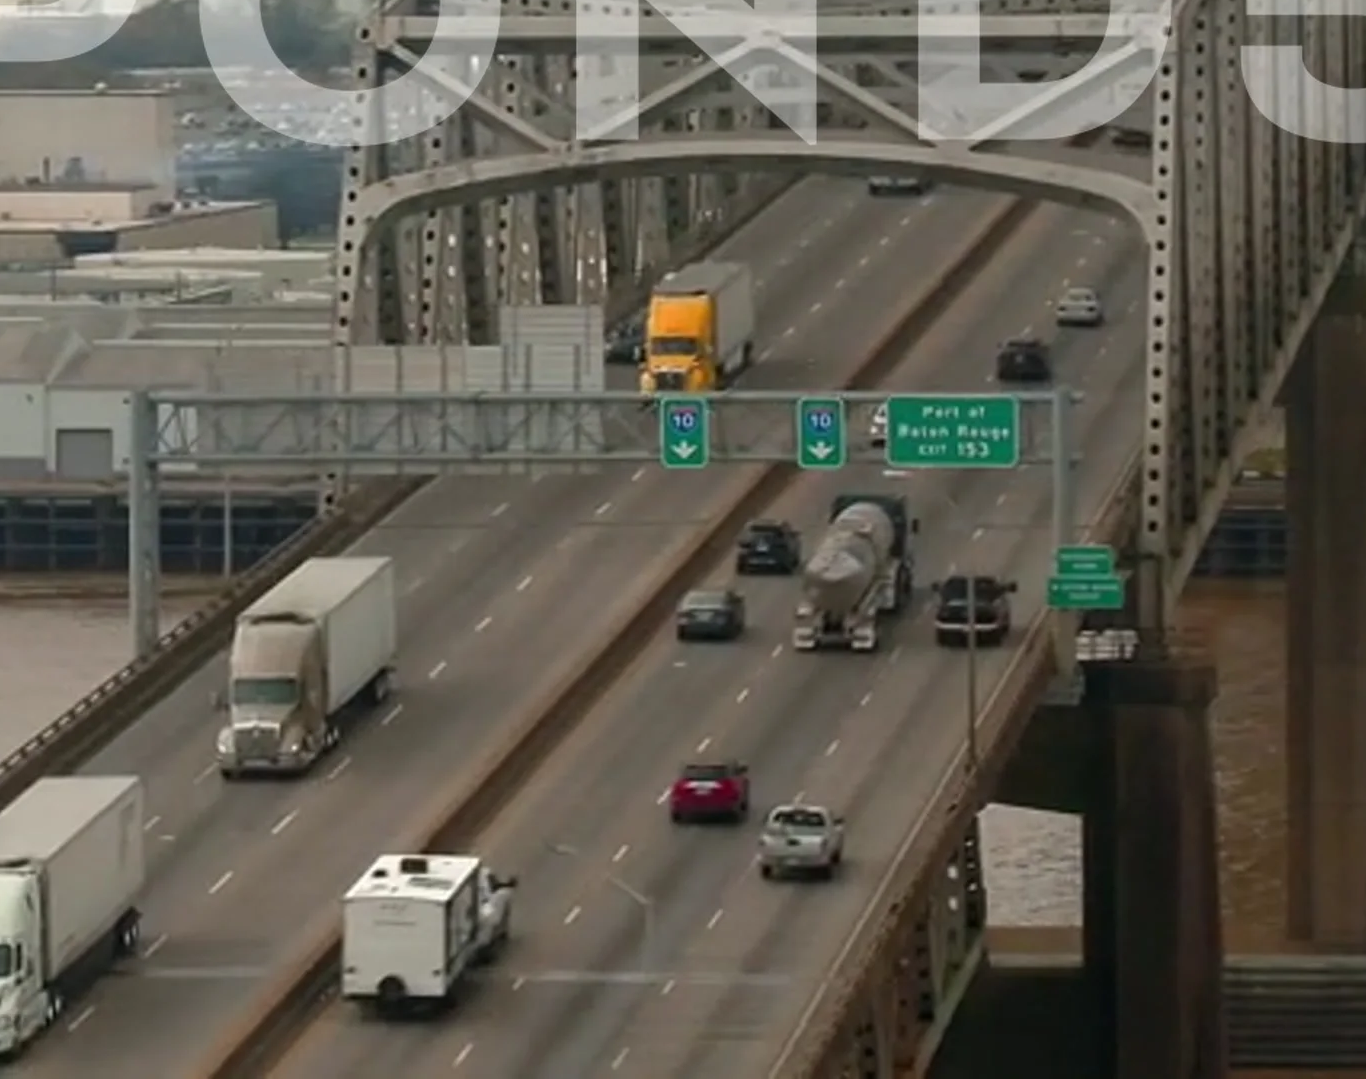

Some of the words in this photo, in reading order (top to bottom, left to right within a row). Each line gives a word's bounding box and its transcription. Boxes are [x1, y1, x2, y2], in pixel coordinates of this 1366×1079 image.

[672, 412, 695, 428] 10
[810, 412, 832, 428] 10
[921, 405, 960, 419] Port
[967, 405, 986, 419] of
[897, 424, 950, 438] Baton
[957, 424, 1010, 441] Rouge
[918, 443, 947, 456] EXIT
[957, 441, 990, 459] 153
